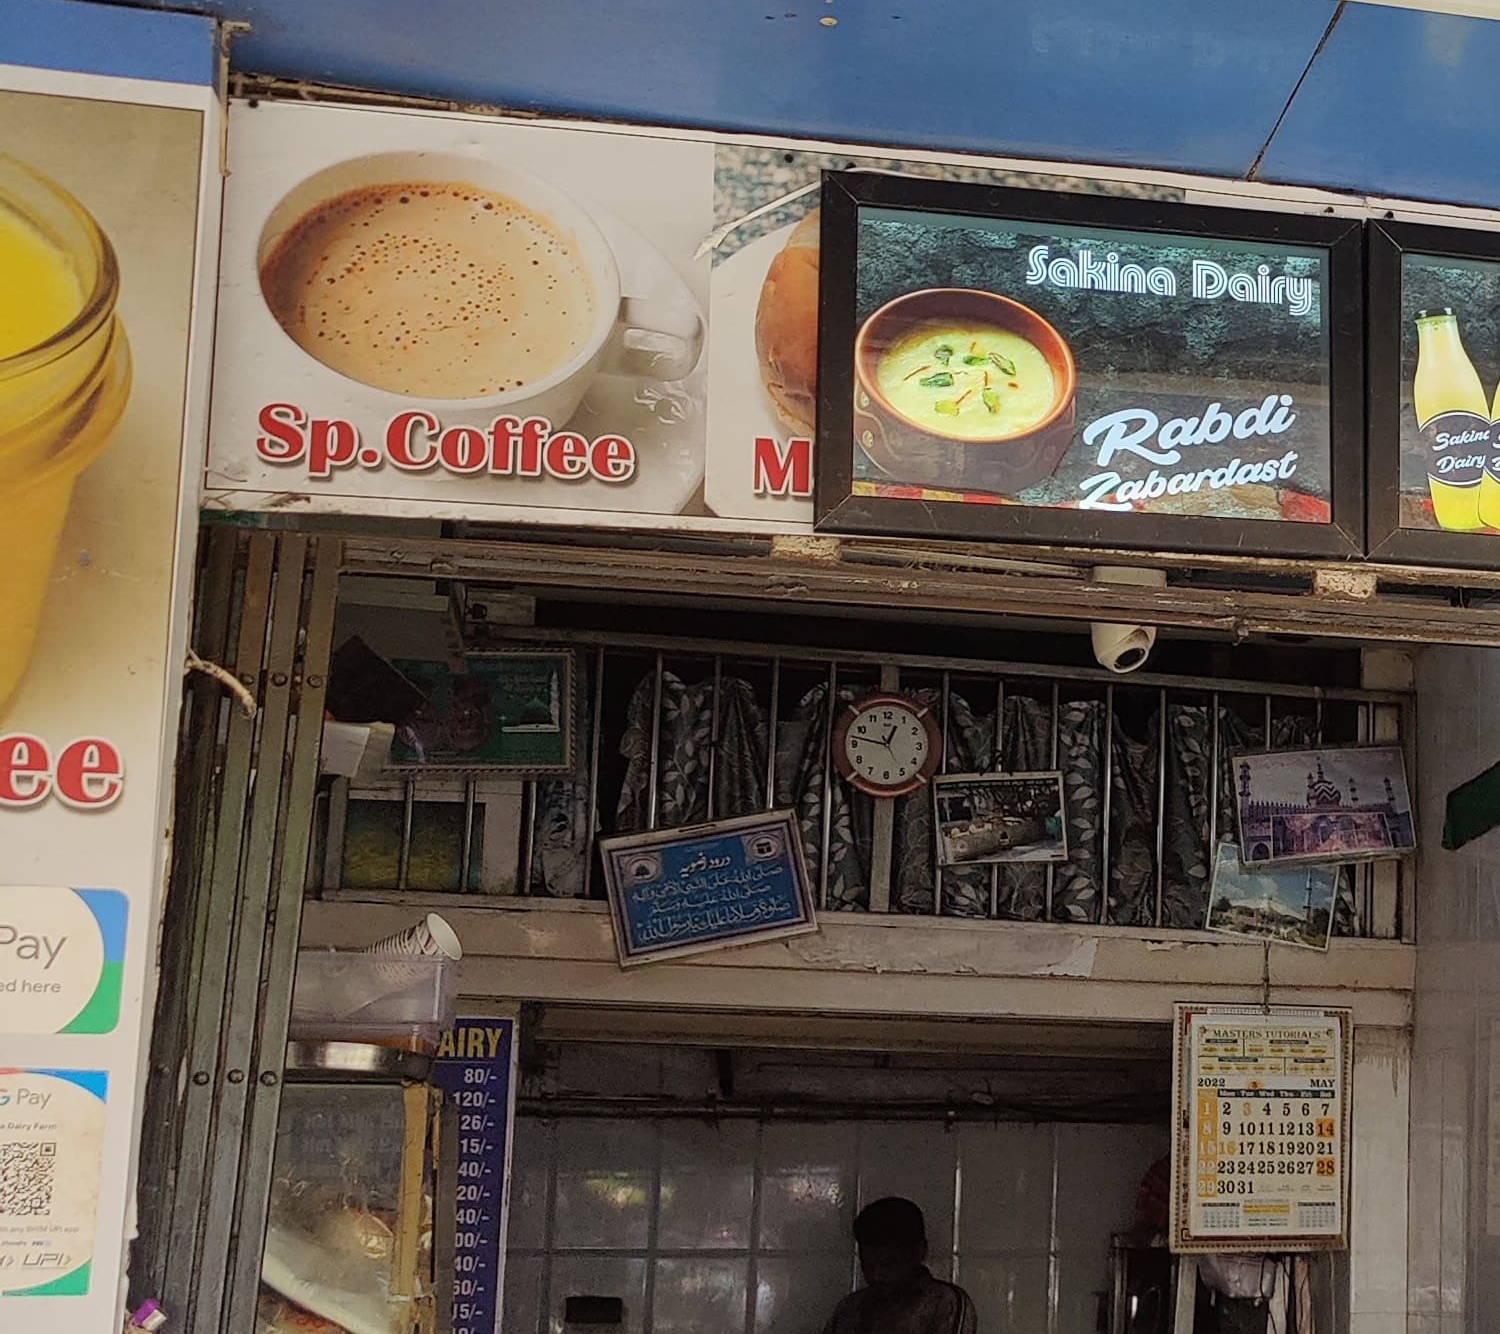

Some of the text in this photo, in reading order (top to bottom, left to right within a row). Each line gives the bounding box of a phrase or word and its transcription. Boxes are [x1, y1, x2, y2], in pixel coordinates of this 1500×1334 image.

[1025, 245, 1312, 316] Sakina Dairy
[1083, 394, 1295, 466] Rabdi
[256, 401, 637, 484] Sp.Coffee
[1437, 455, 1486, 473] Dairy
[1079, 450, 1298, 512] Zabardast
[22, 979, 62, 993] here
[438, 1027, 503, 1058] AIRY
[1213, 1029, 1322, 1040] MASTERS TUTORIALS
[464, 1069, 498, 1085] 80/-
[1198, 1078, 1335, 1088] 2022 MAY
[17, 1088, 52, 1109] Pay
[453, 1092, 496, 1108] 120/-
[1222, 1102, 1232, 1116] 2
[1262, 1102, 1272, 1116] 4
[1282, 1102, 1291, 1116] 5
[1301, 1102, 1310, 1116] 6
[1321, 1102, 1330, 1116] 7
[460, 1115, 494, 1131] 26/-
[1222, 1122, 1335, 1136] 9 10 11 12 13 14
[459, 1138, 493, 1155] 15/-
[1238, 1141, 1255, 1155] 17
[1258, 1141, 1275, 1155] 18
[1278, 1141, 1295, 1155] 19
[1296, 1141, 1314, 1155] 20
[1316, 1141, 1334, 1155] 21
[457, 1162, 491, 1178] 40/-
[1217, 1160, 1335, 1175] 23 24 25 26 27 28
[1217, 1180, 1255, 1194] 30 31
